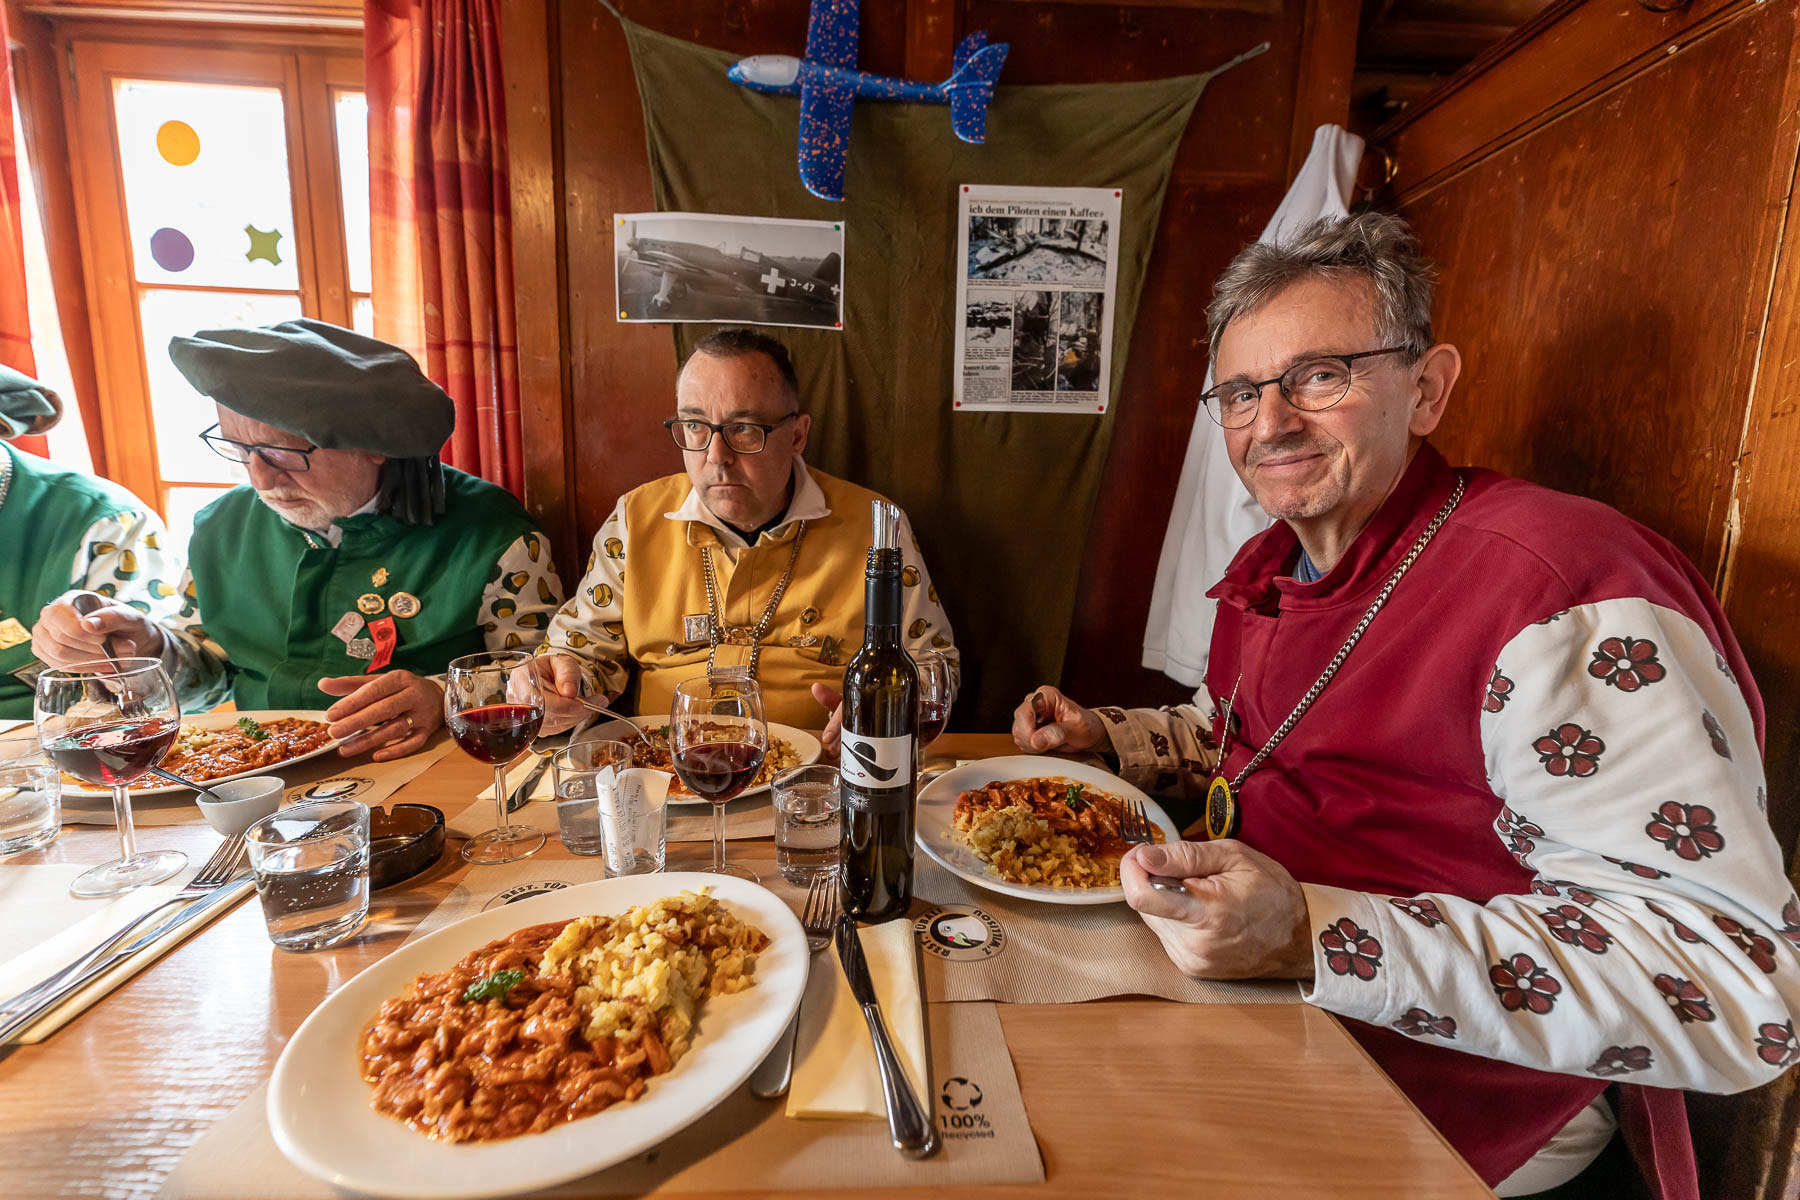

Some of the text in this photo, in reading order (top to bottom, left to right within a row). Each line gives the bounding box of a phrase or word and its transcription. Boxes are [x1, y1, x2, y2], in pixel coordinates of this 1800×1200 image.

[969, 204, 983, 214] ich
[985, 205, 1005, 214] dem
[1007, 205, 1040, 216] Piloten
[1042, 207, 1066, 217] einen
[790, 278, 816, 293] J-47
[941, 1113, 991, 1129] 100%
